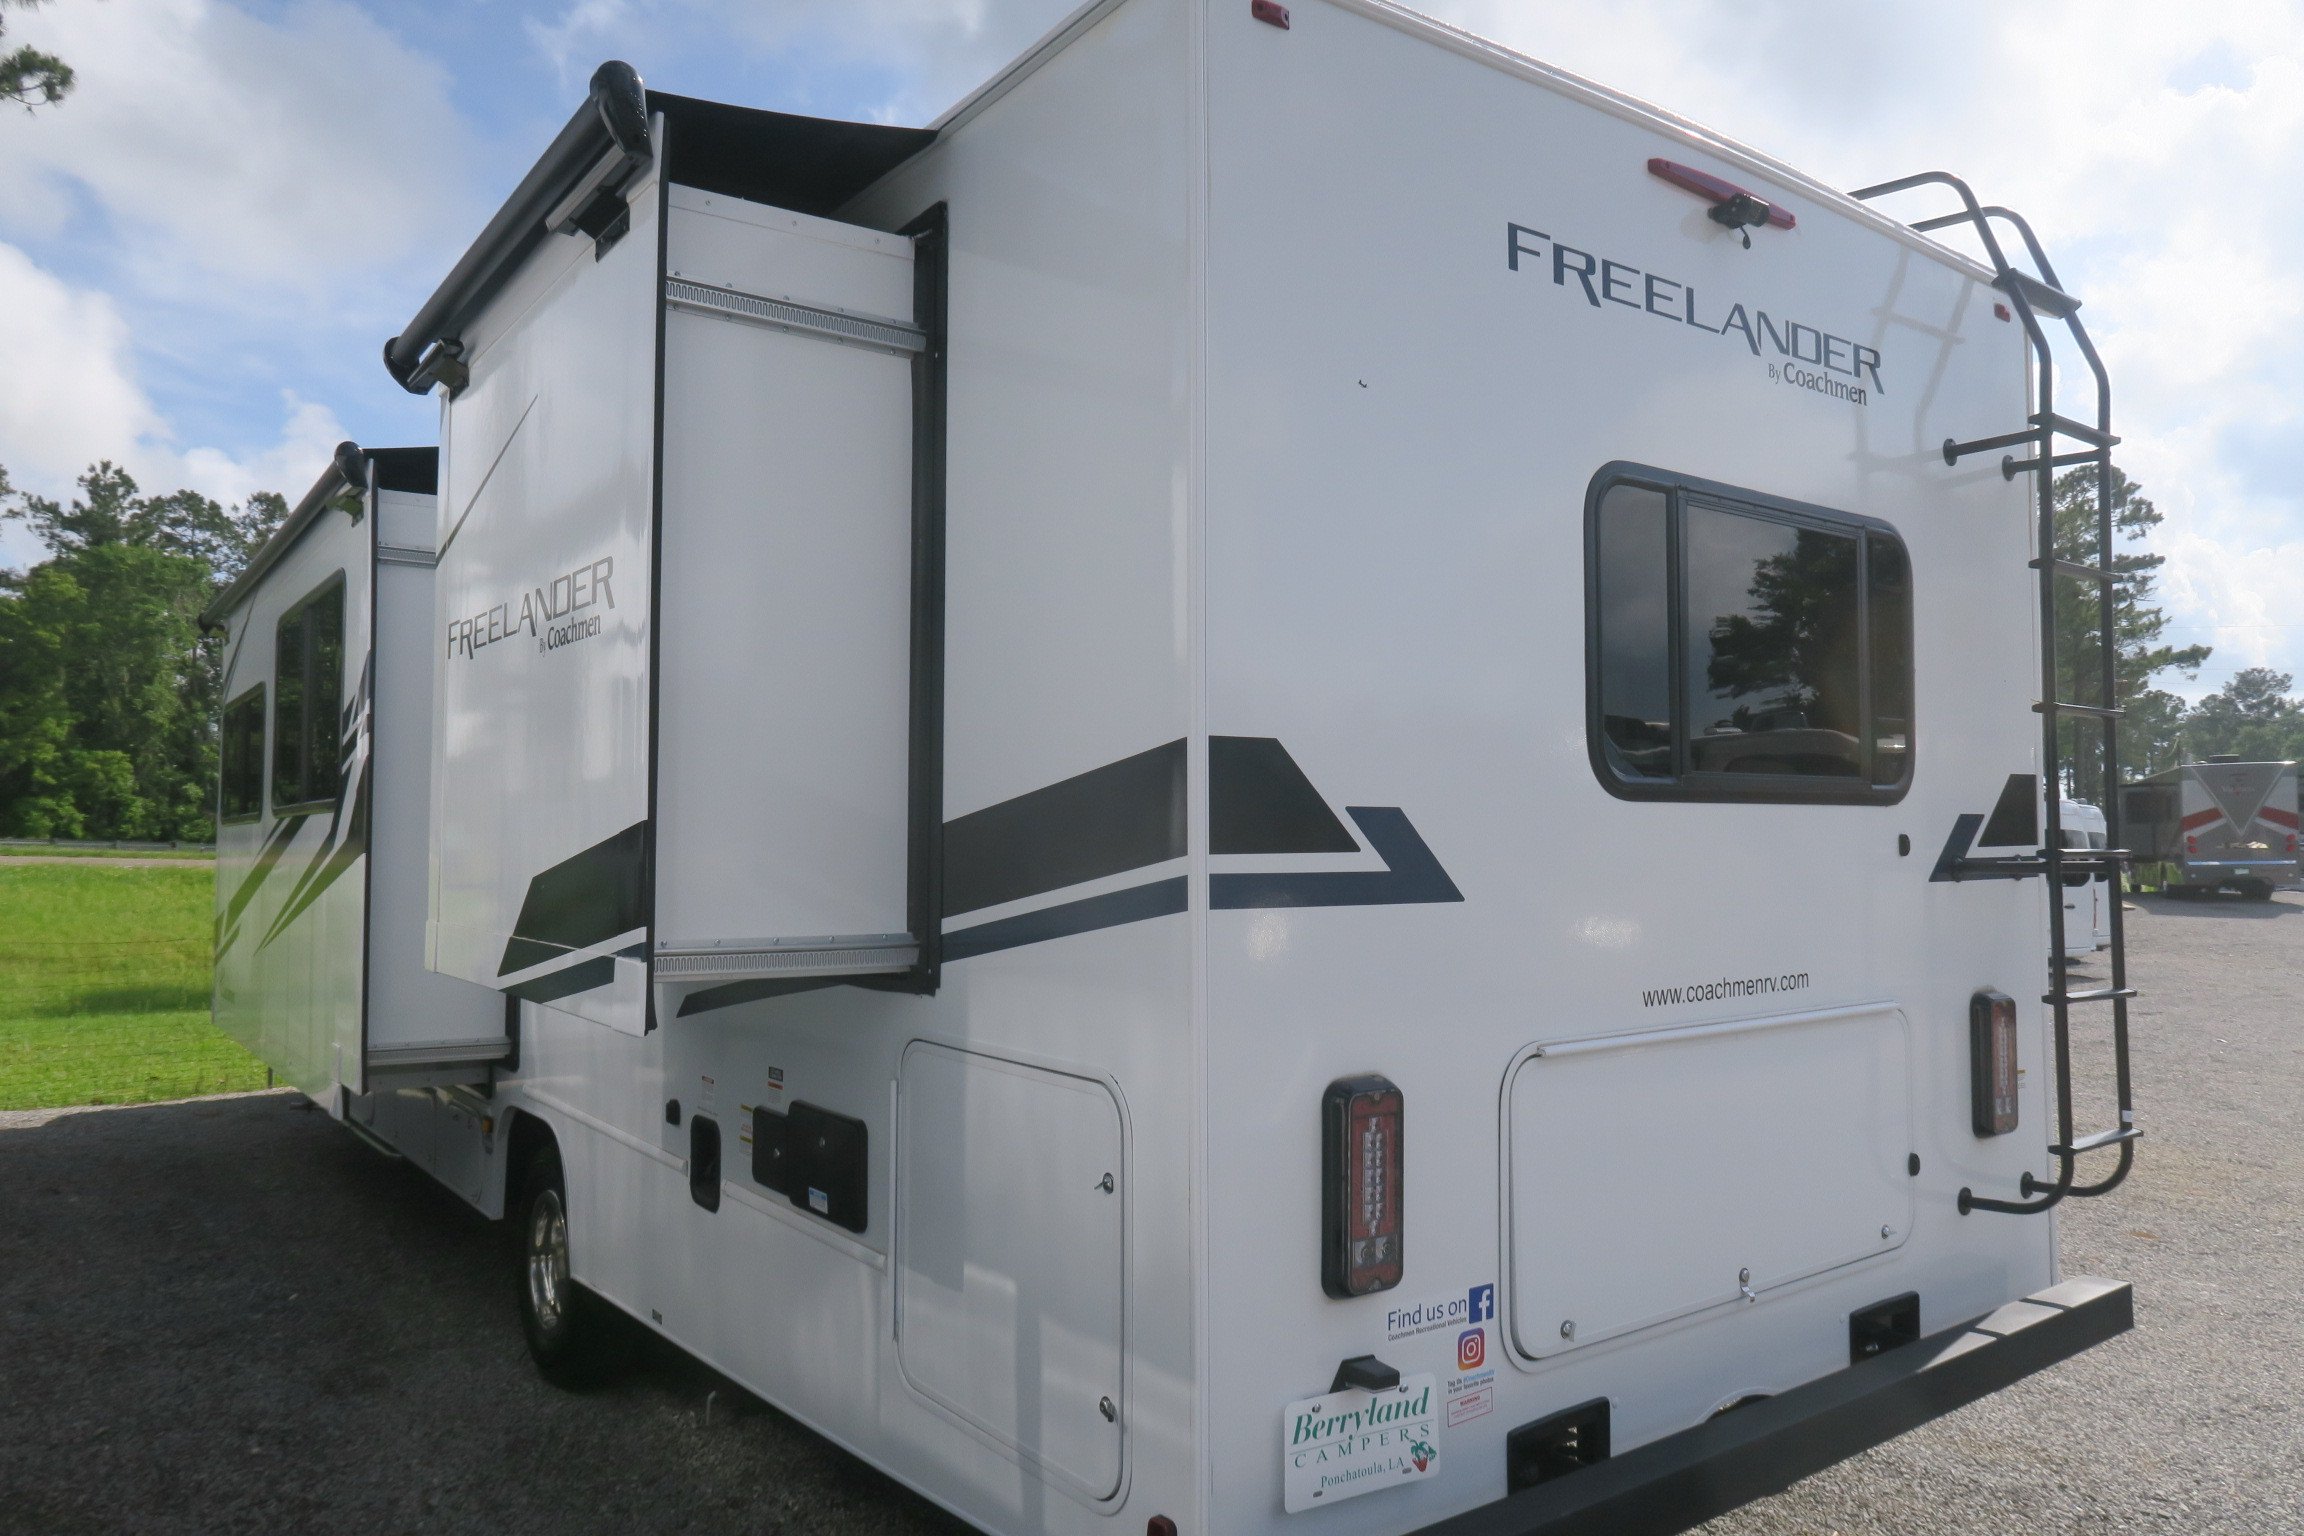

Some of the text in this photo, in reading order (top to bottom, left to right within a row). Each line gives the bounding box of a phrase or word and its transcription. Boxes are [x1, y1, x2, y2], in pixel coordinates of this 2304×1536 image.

[1508, 222, 1884, 396] FREELANDER
[1768, 362, 1867, 407] By Coachmen
[447, 556, 616, 660] FREELANDER
[539, 614, 602, 658] By Coachmen
[1642, 972, 1809, 1008] www.coachmenrv.com
[1388, 1303, 1422, 1331] Find
[1426, 1304, 1444, 1321] us
[1448, 1299, 1467, 1316] on
[1388, 1316, 1467, 1342] Coachmen Recreational Vehicles
[1292, 1386, 1430, 1445] Berryland
[1294, 1424, 1429, 1468] CAMPERS
[1320, 1456, 1405, 1488] Ponchatoula, LA
